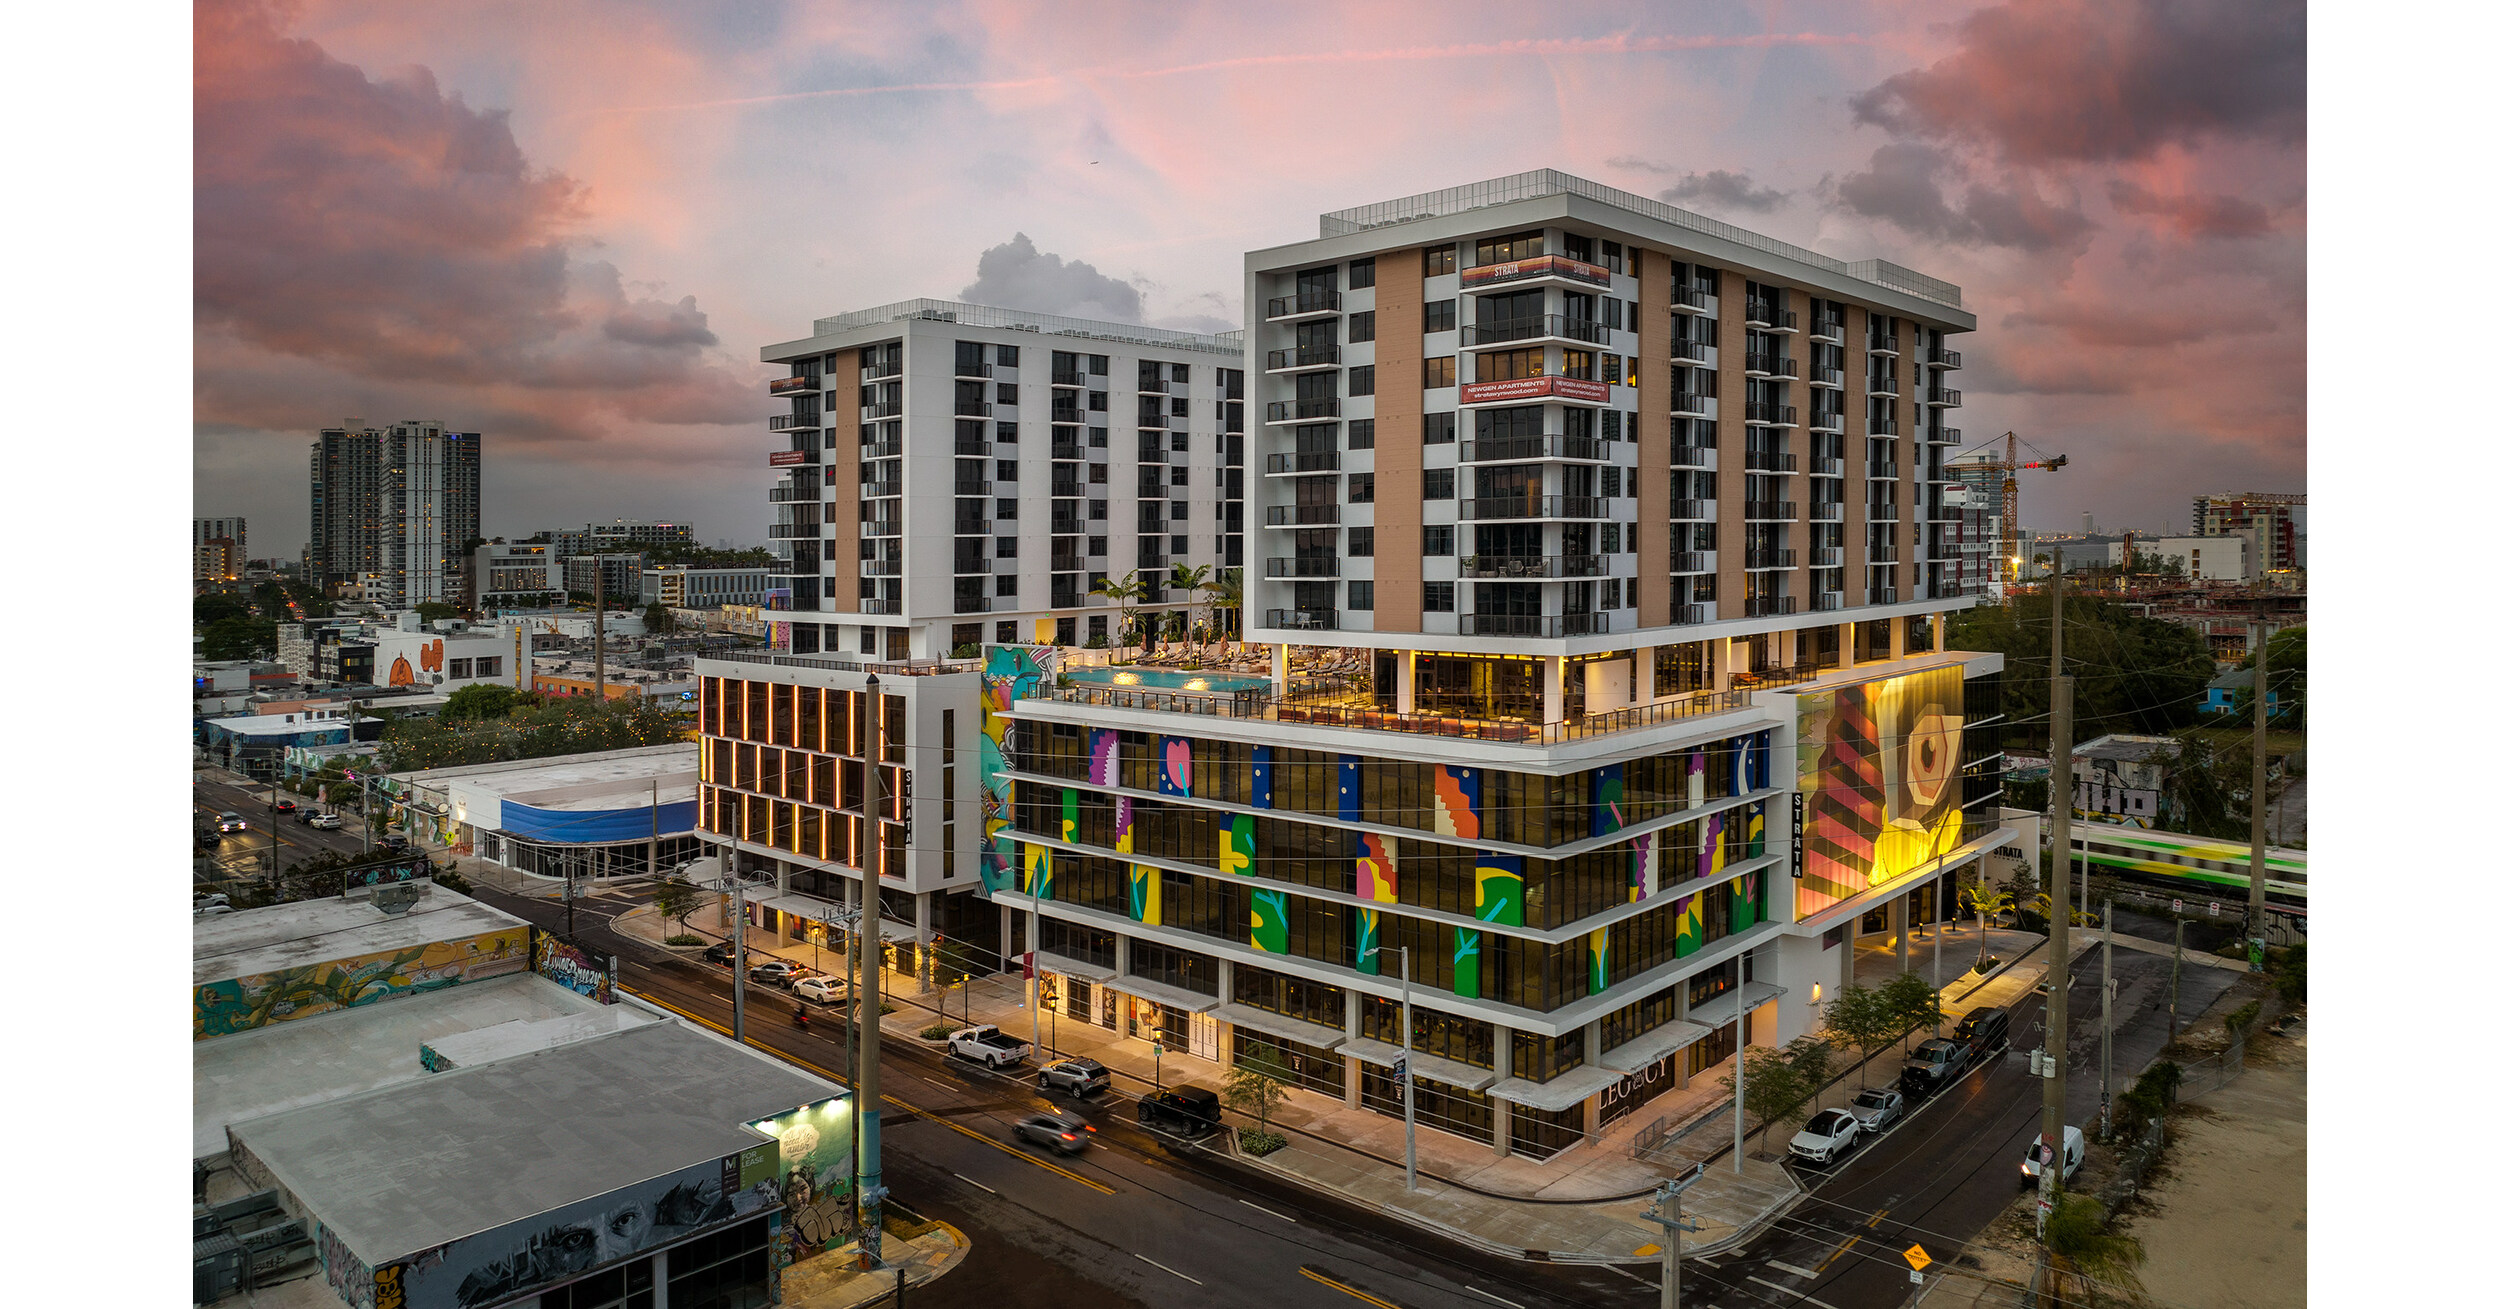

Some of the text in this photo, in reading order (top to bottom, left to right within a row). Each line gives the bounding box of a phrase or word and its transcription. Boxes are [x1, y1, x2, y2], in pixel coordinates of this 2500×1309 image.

[1494, 263, 1519, 277] STRATA
[1573, 263, 1590, 276] STRATA
[1467, 380, 1545, 393] NEWGEN APARTMENTS
[1993, 845, 2023, 859] STRATA
[741, 1151, 757, 1160] FOR
[741, 1156, 764, 1168] LEASE
